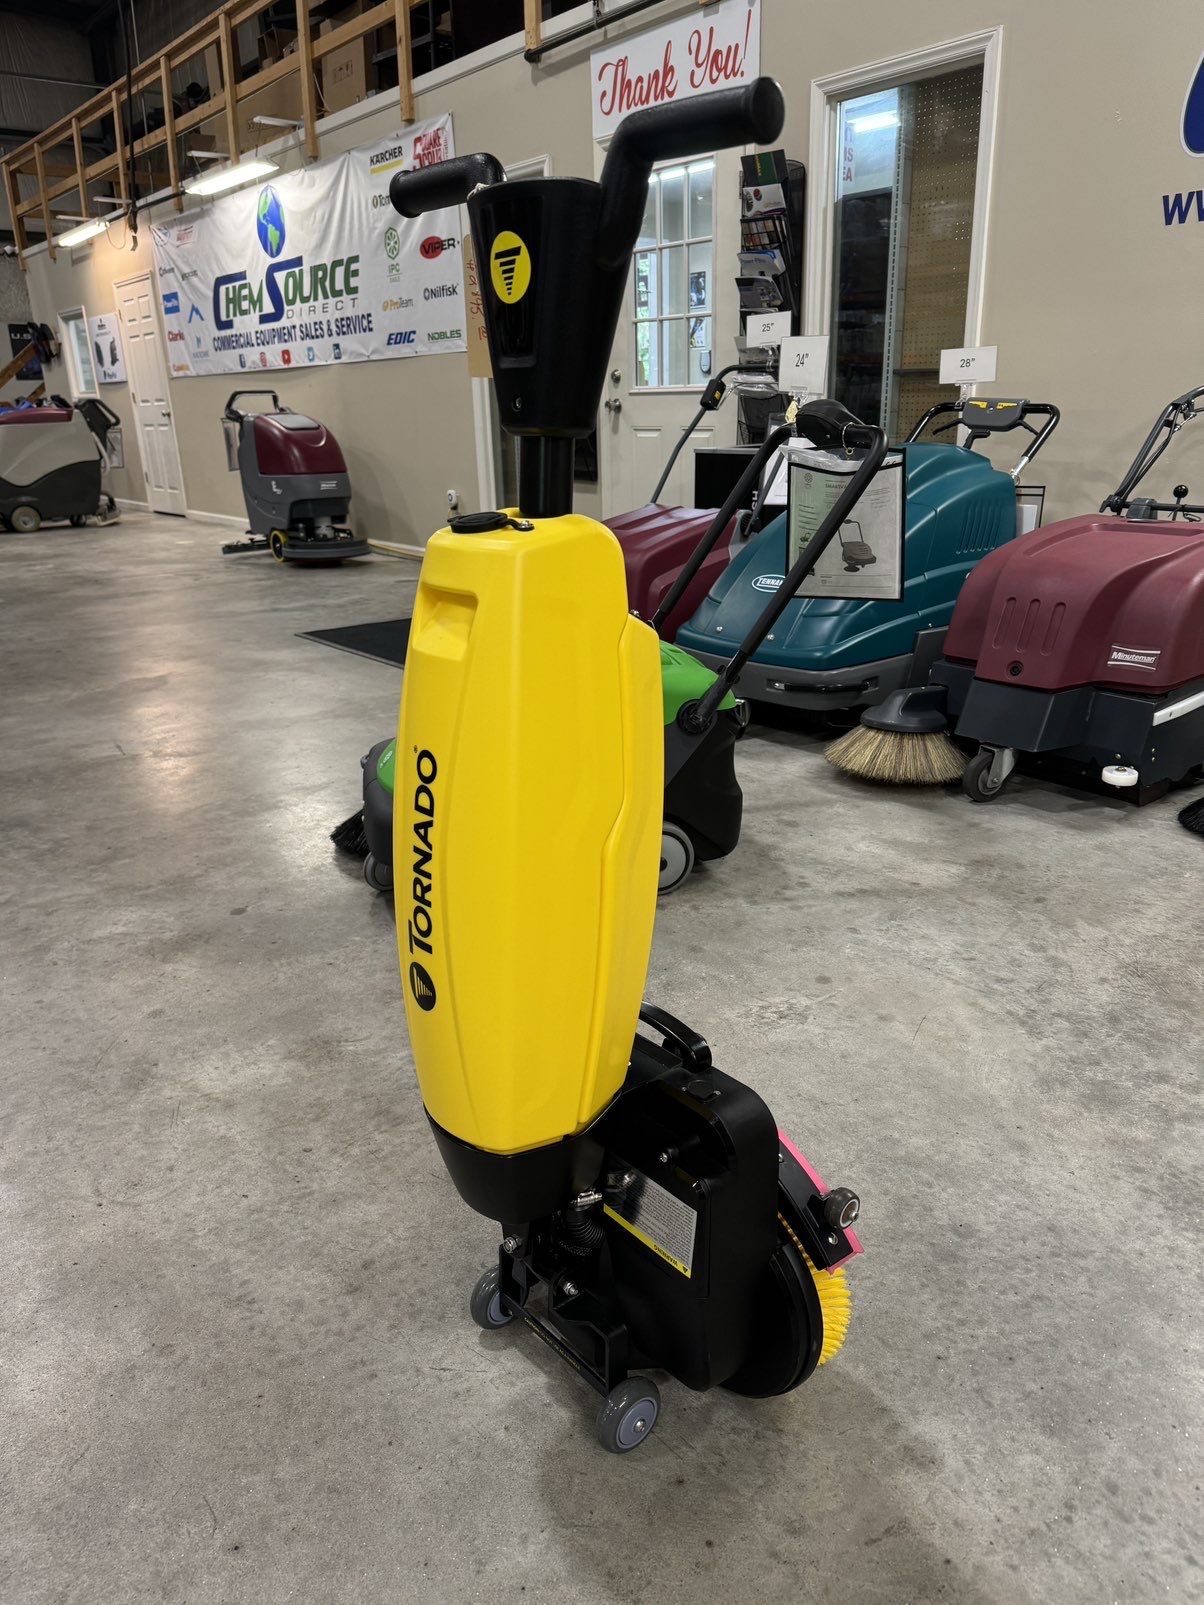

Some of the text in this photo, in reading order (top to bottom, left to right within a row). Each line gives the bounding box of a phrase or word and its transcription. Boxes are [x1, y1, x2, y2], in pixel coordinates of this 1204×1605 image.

[598, 9, 752, 116] Thank You!
[422, 238, 455, 255] VIPER
[388, 263, 400, 274] IPC
[430, 285, 458, 300] Nilfisk
[286, 297, 359, 320] DIRECT
[212, 312, 374, 352] COMMERCIAL EQUIPMENT SALES & SERVICE
[762, 322, 774, 332] 25"
[386, 330, 417, 346] EDIC
[427, 329, 462, 342] NOBLES
[795, 353, 809, 367] 24"
[960, 357, 976, 368] 28"
[1111, 651, 1156, 664] Minuteman
[408, 748, 438, 955] TORNADO
[653, 1244, 678, 1267] WARNING
